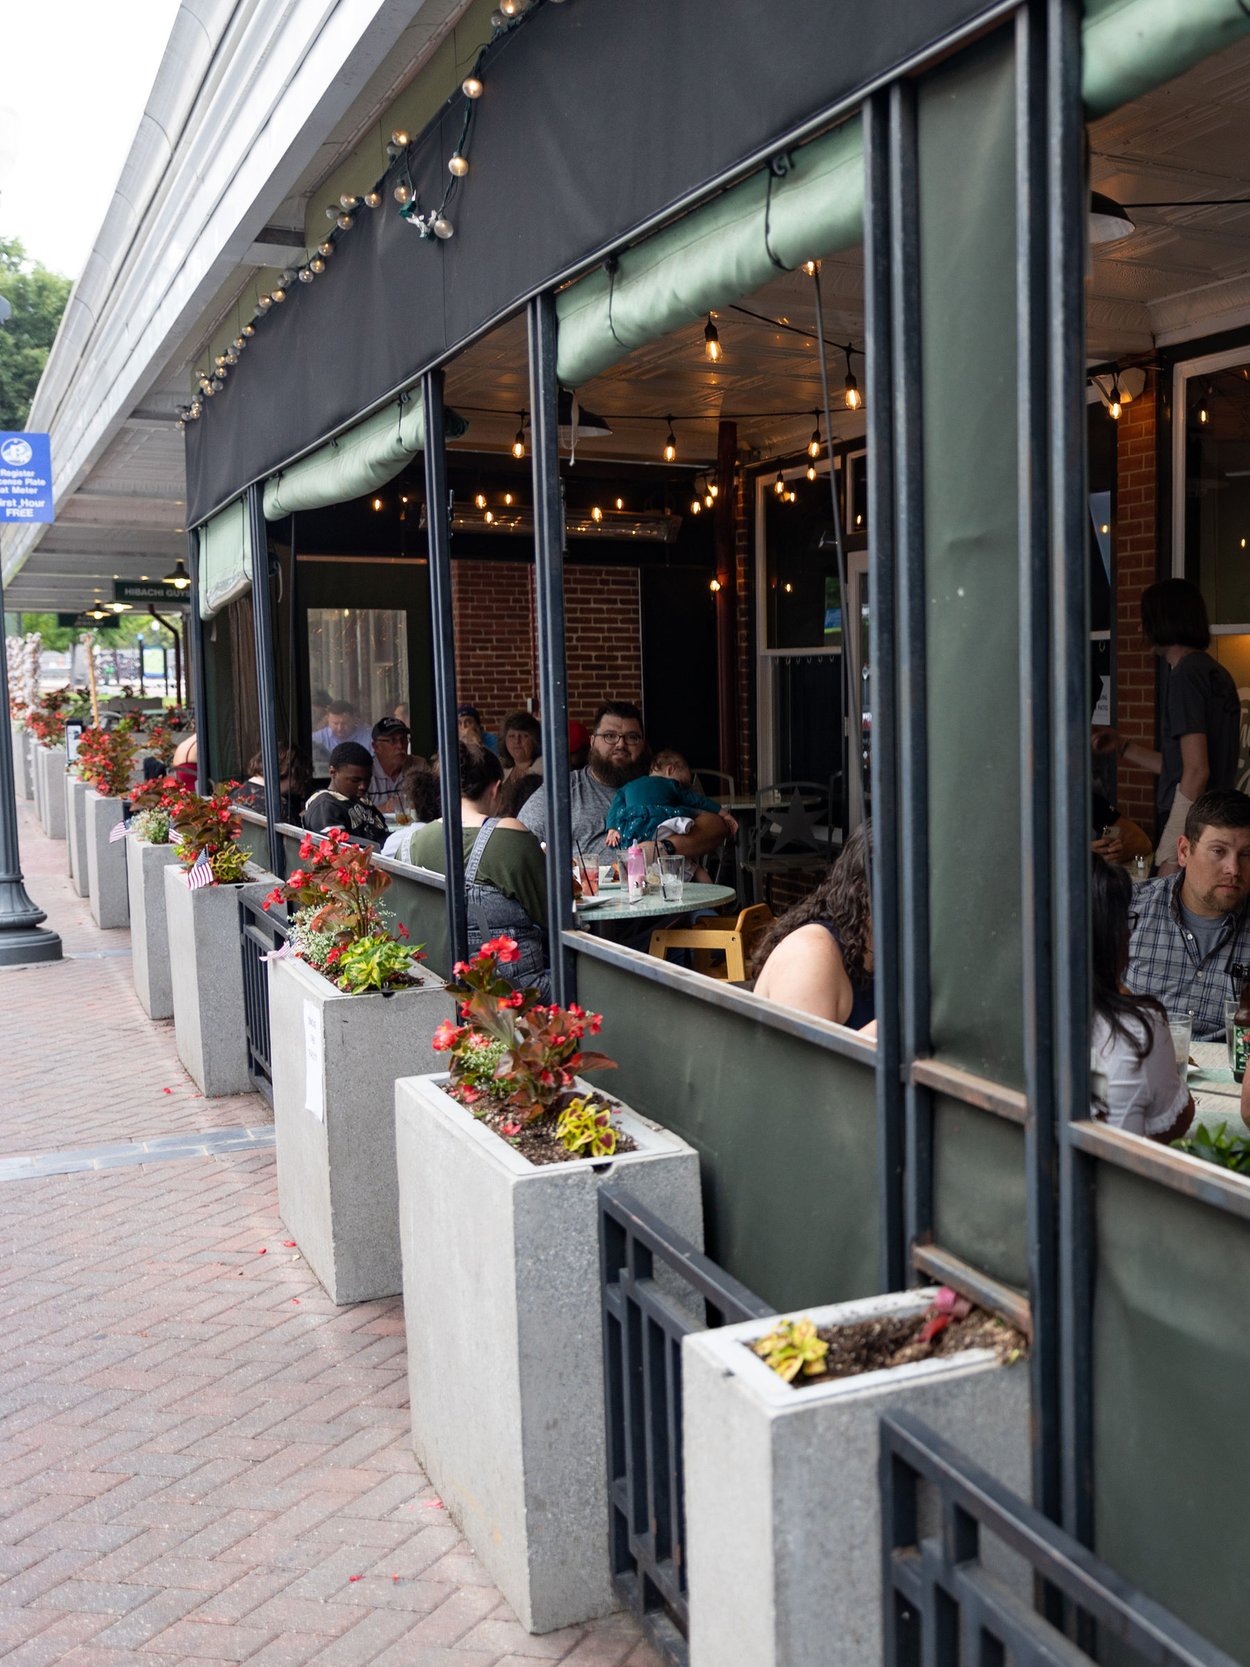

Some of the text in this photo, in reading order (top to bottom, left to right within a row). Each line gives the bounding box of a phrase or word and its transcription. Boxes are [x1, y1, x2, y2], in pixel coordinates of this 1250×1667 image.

[0, 469, 35, 478] Register
[25, 478, 46, 487] Plate
[12, 486, 38, 494] Meter
[21, 498, 46, 507] Hour
[6, 509, 34, 517] FREE
[124, 587, 164, 597] HIBACHI
